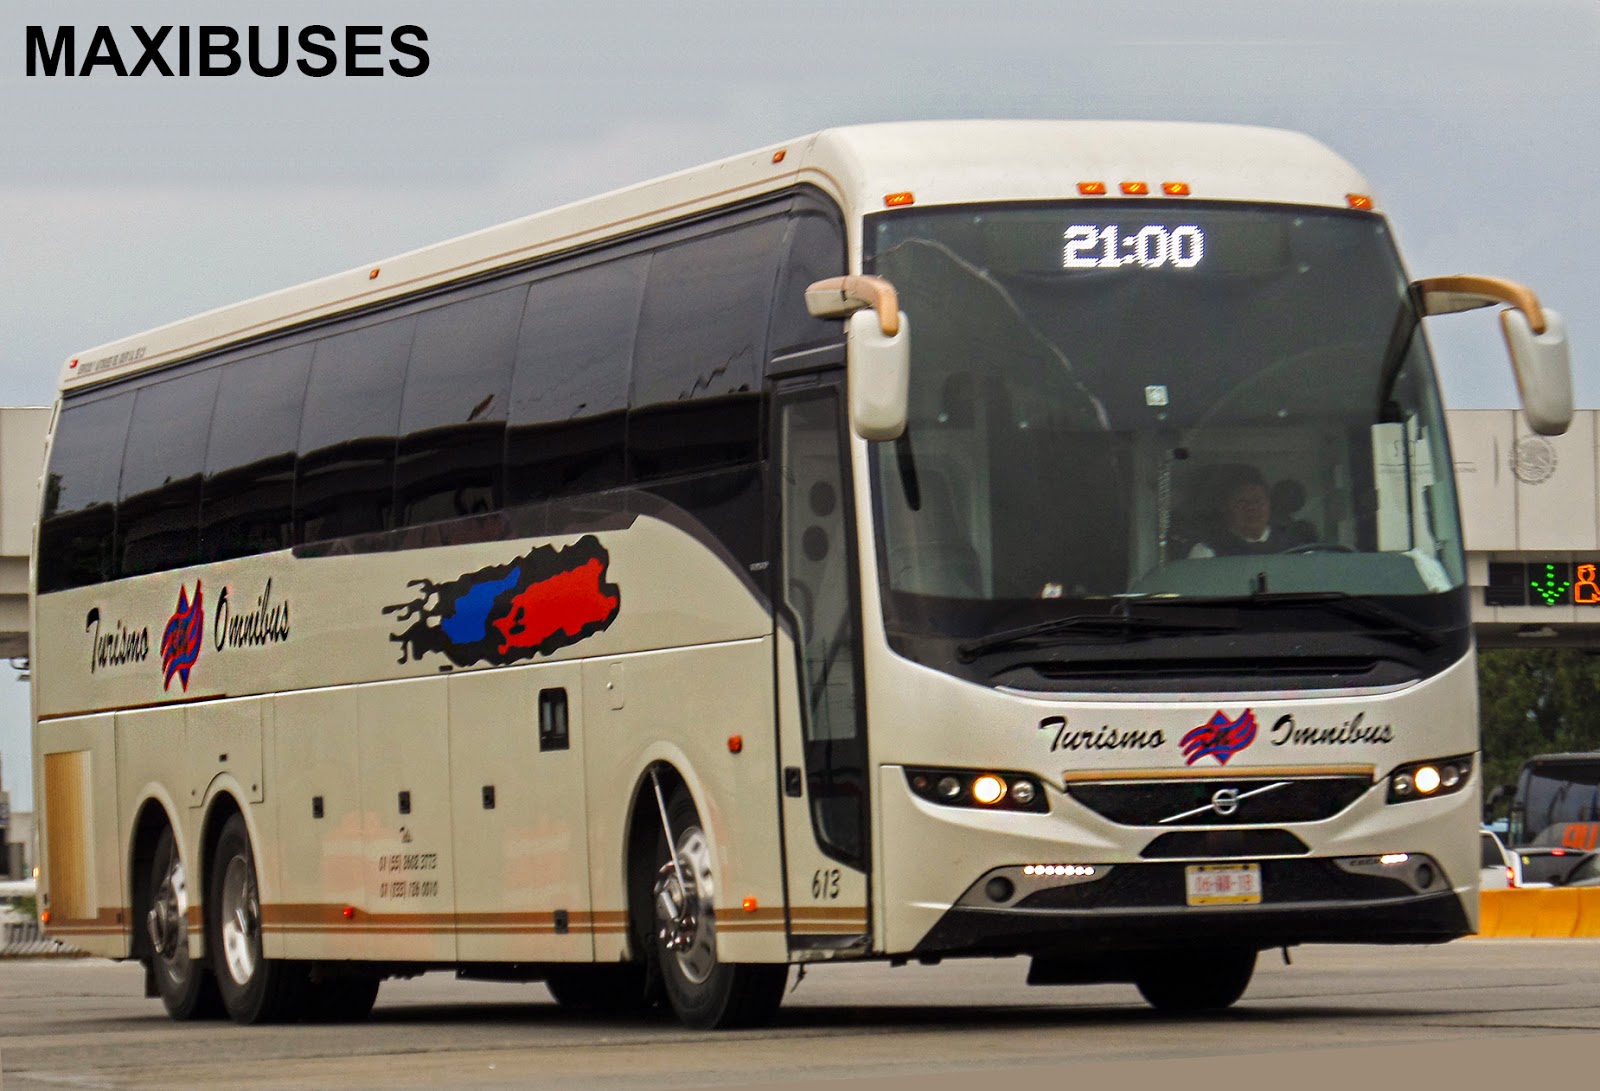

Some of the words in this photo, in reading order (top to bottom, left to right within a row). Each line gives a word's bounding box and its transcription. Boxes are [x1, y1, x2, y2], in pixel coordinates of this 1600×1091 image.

[1062, 224, 1206, 268] 21:00
[85, 606, 149, 674] Turismo
[214, 576, 290, 652] Omnibus
[1038, 715, 1166, 752] Turismo
[1271, 710, 1395, 746] Omnibus
[812, 868, 841, 899] 613
